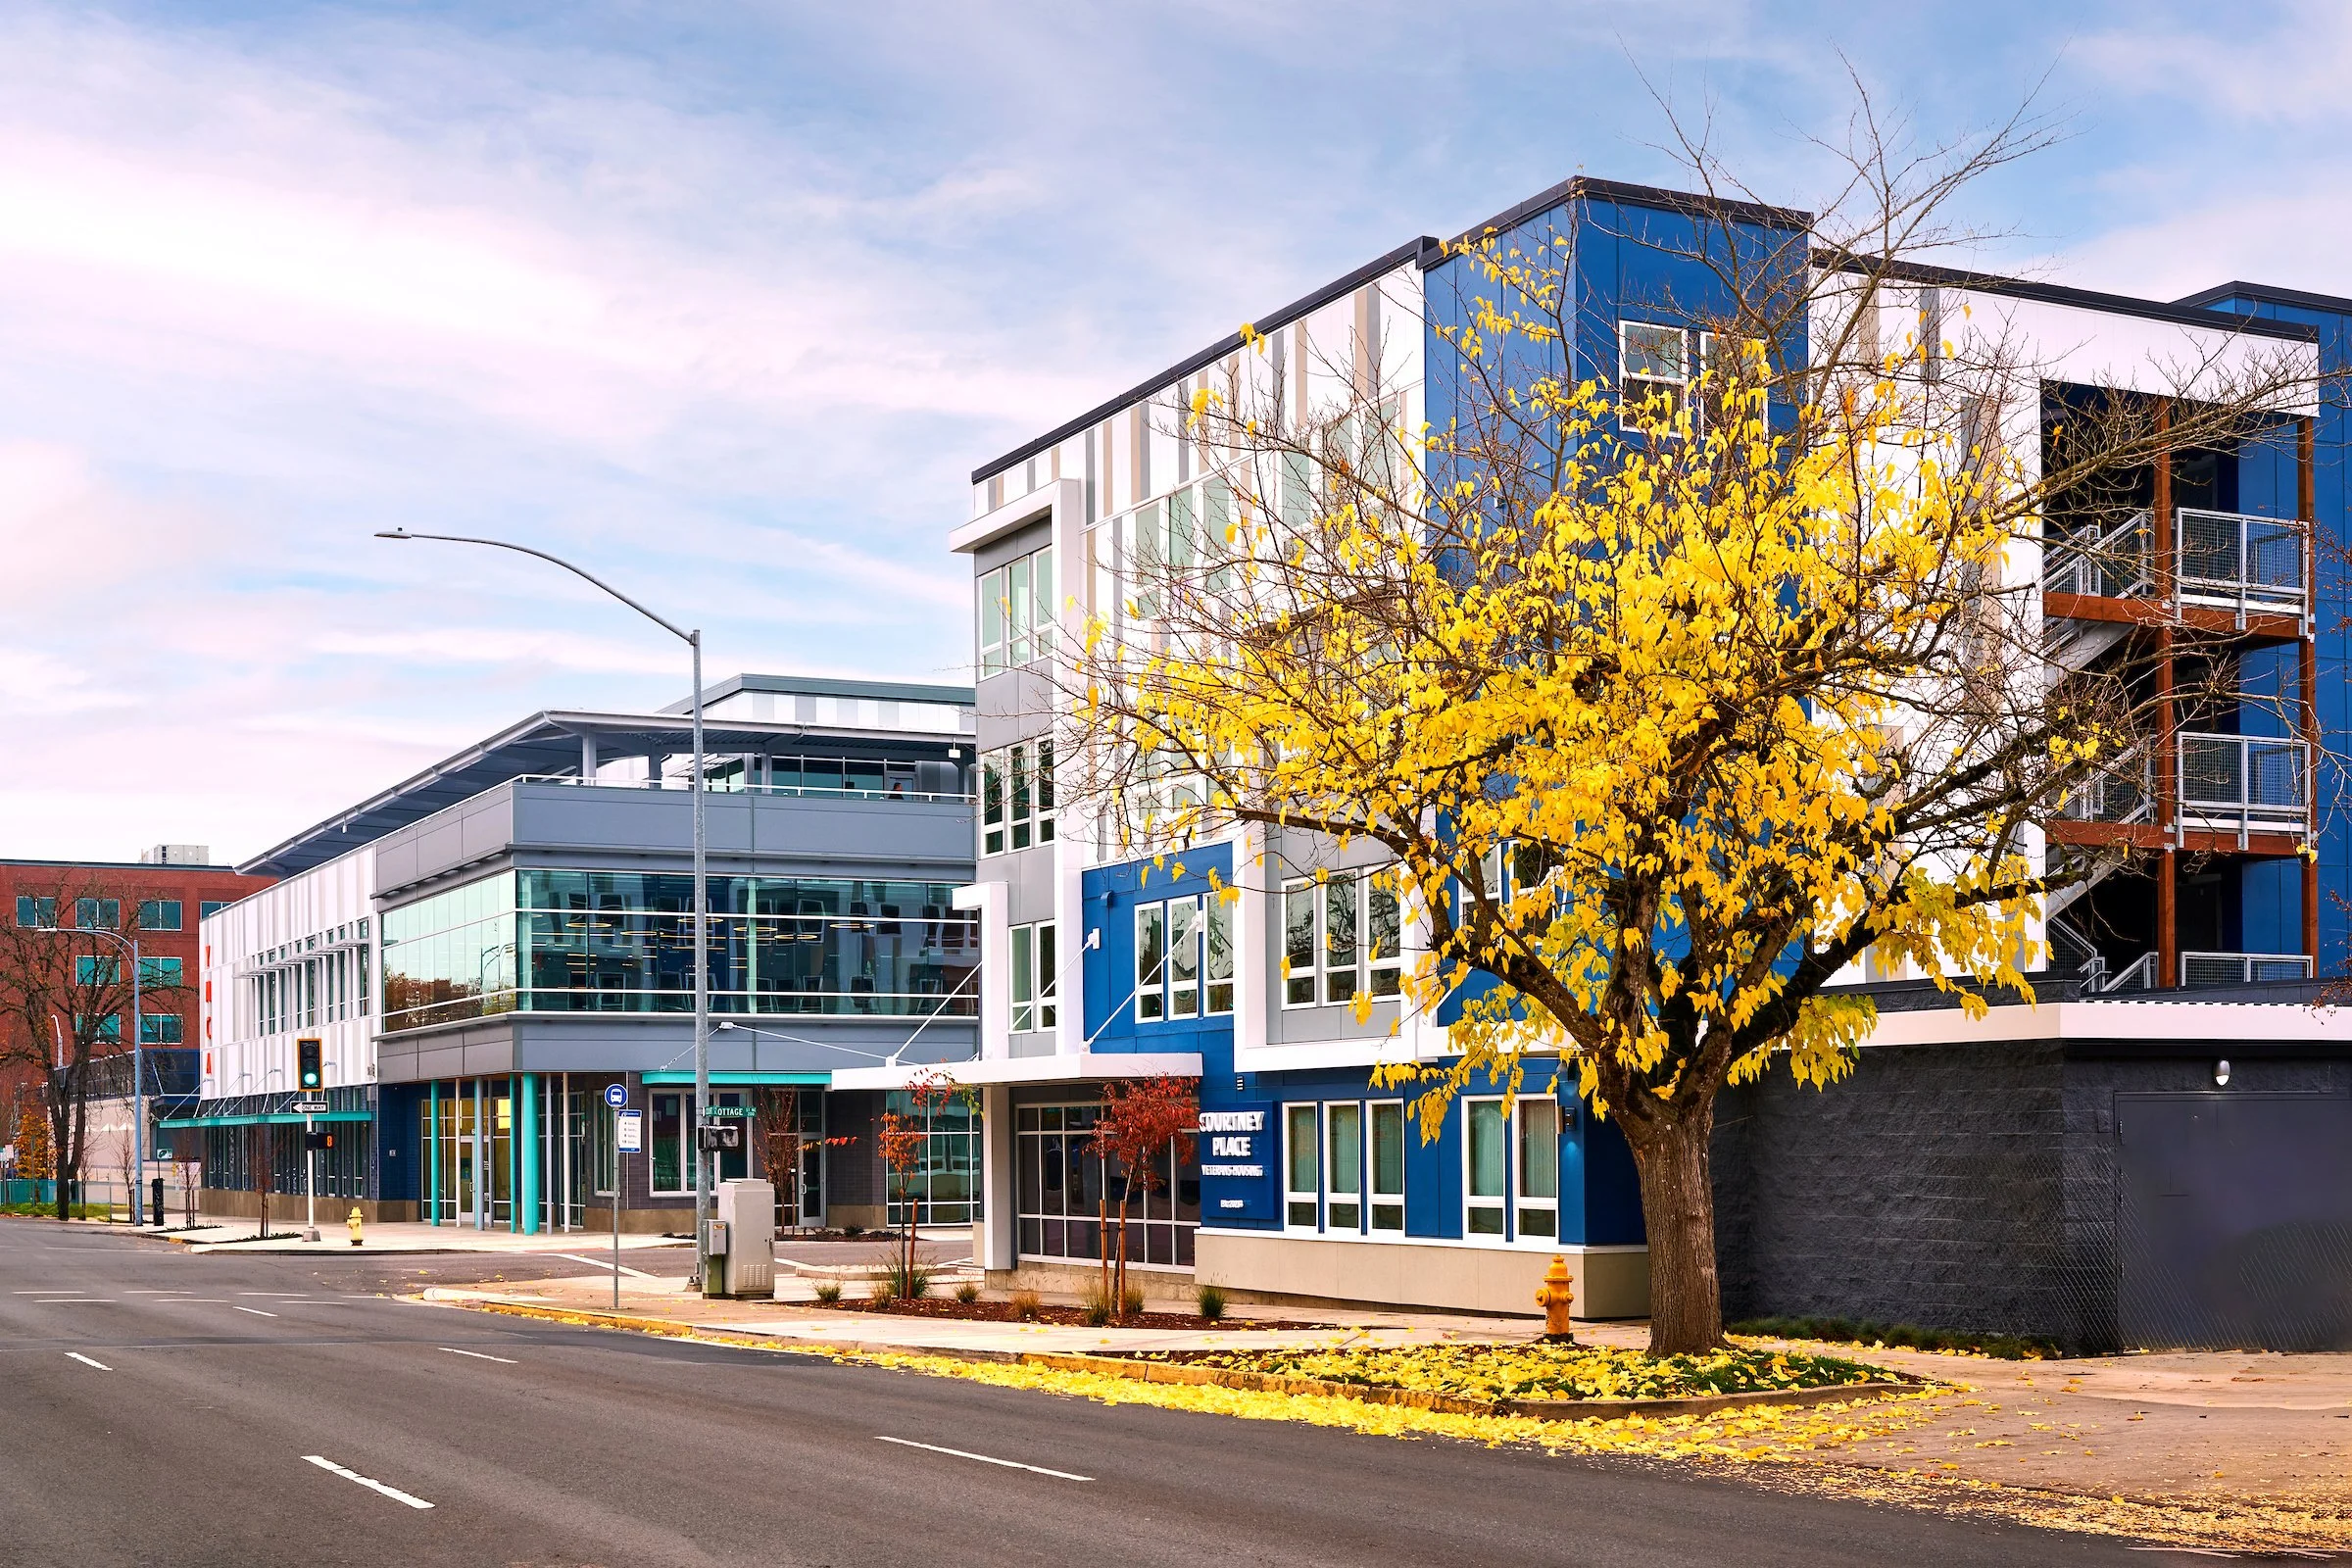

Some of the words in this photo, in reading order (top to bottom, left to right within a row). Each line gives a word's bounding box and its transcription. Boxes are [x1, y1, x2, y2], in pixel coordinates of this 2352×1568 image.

[717, 1107, 744, 1116] OTTAGE
[1199, 1111, 1264, 1132] COURTNEY
[1212, 1137, 1251, 1156] PLACE
